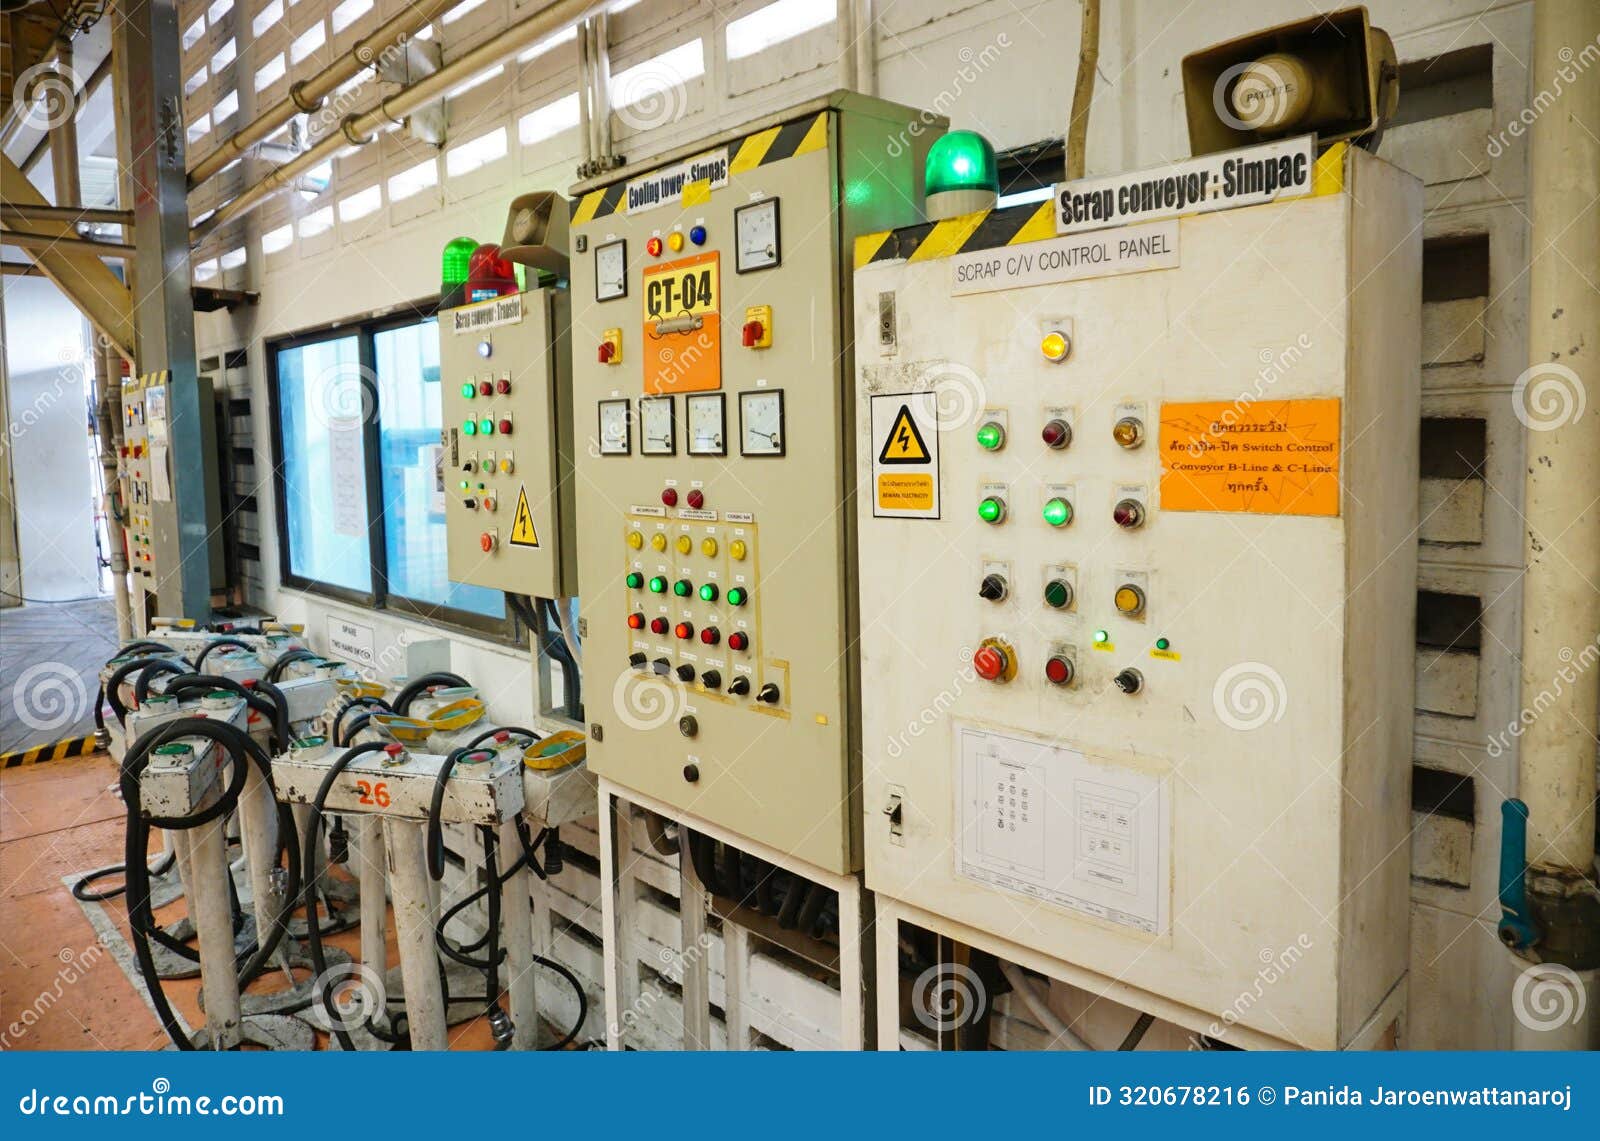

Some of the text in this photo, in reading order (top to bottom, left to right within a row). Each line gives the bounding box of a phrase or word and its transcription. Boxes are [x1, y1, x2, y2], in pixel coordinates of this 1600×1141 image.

[629, 181, 659, 209] Cooling
[661, 172, 686, 198] tower
[691, 158, 726, 186] Simpac
[1061, 190, 1114, 225] Scrap
[1118, 170, 1209, 216] conveyor
[1222, 152, 1307, 198] Simpac
[957, 234, 1171, 282] SCRAP C/V CONTROL PANEL
[647, 270, 712, 315] CT-04
[1170, 462, 1332, 473] Conveyor B-Line & C-Line
[1242, 443, 1283, 452] Switch
[1286, 443, 1333, 452] Control
[357, 779, 392, 808] 26
